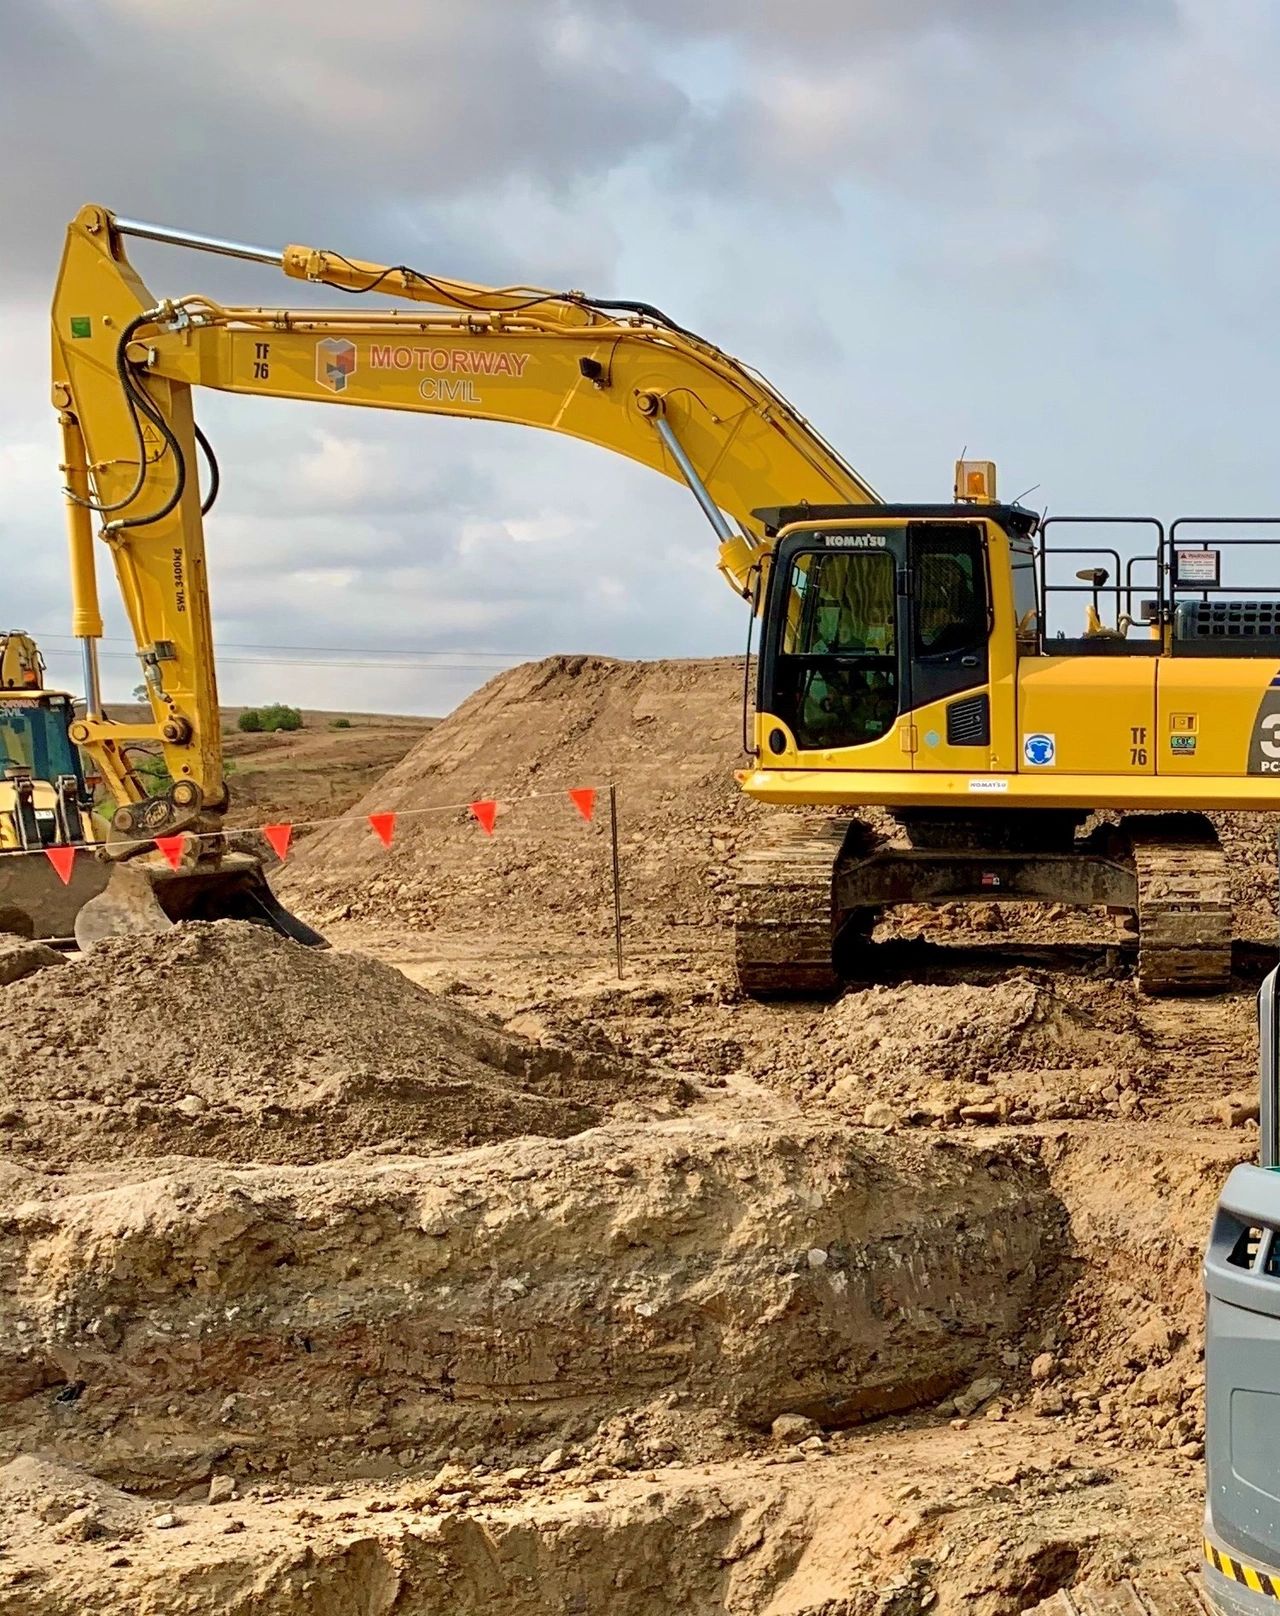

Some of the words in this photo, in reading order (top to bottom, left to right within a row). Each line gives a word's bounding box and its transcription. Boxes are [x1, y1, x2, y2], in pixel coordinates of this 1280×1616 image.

[255, 343, 270, 359] TF
[370, 344, 529, 376] MOTORWAY
[254, 362, 269, 379] 76
[420, 378, 481, 402] CIVIL
[825, 534, 886, 548] KOMATSU
[176, 589, 186, 612] SWL
[1130, 727, 1147, 744] TF
[1130, 749, 1147, 766] 76
